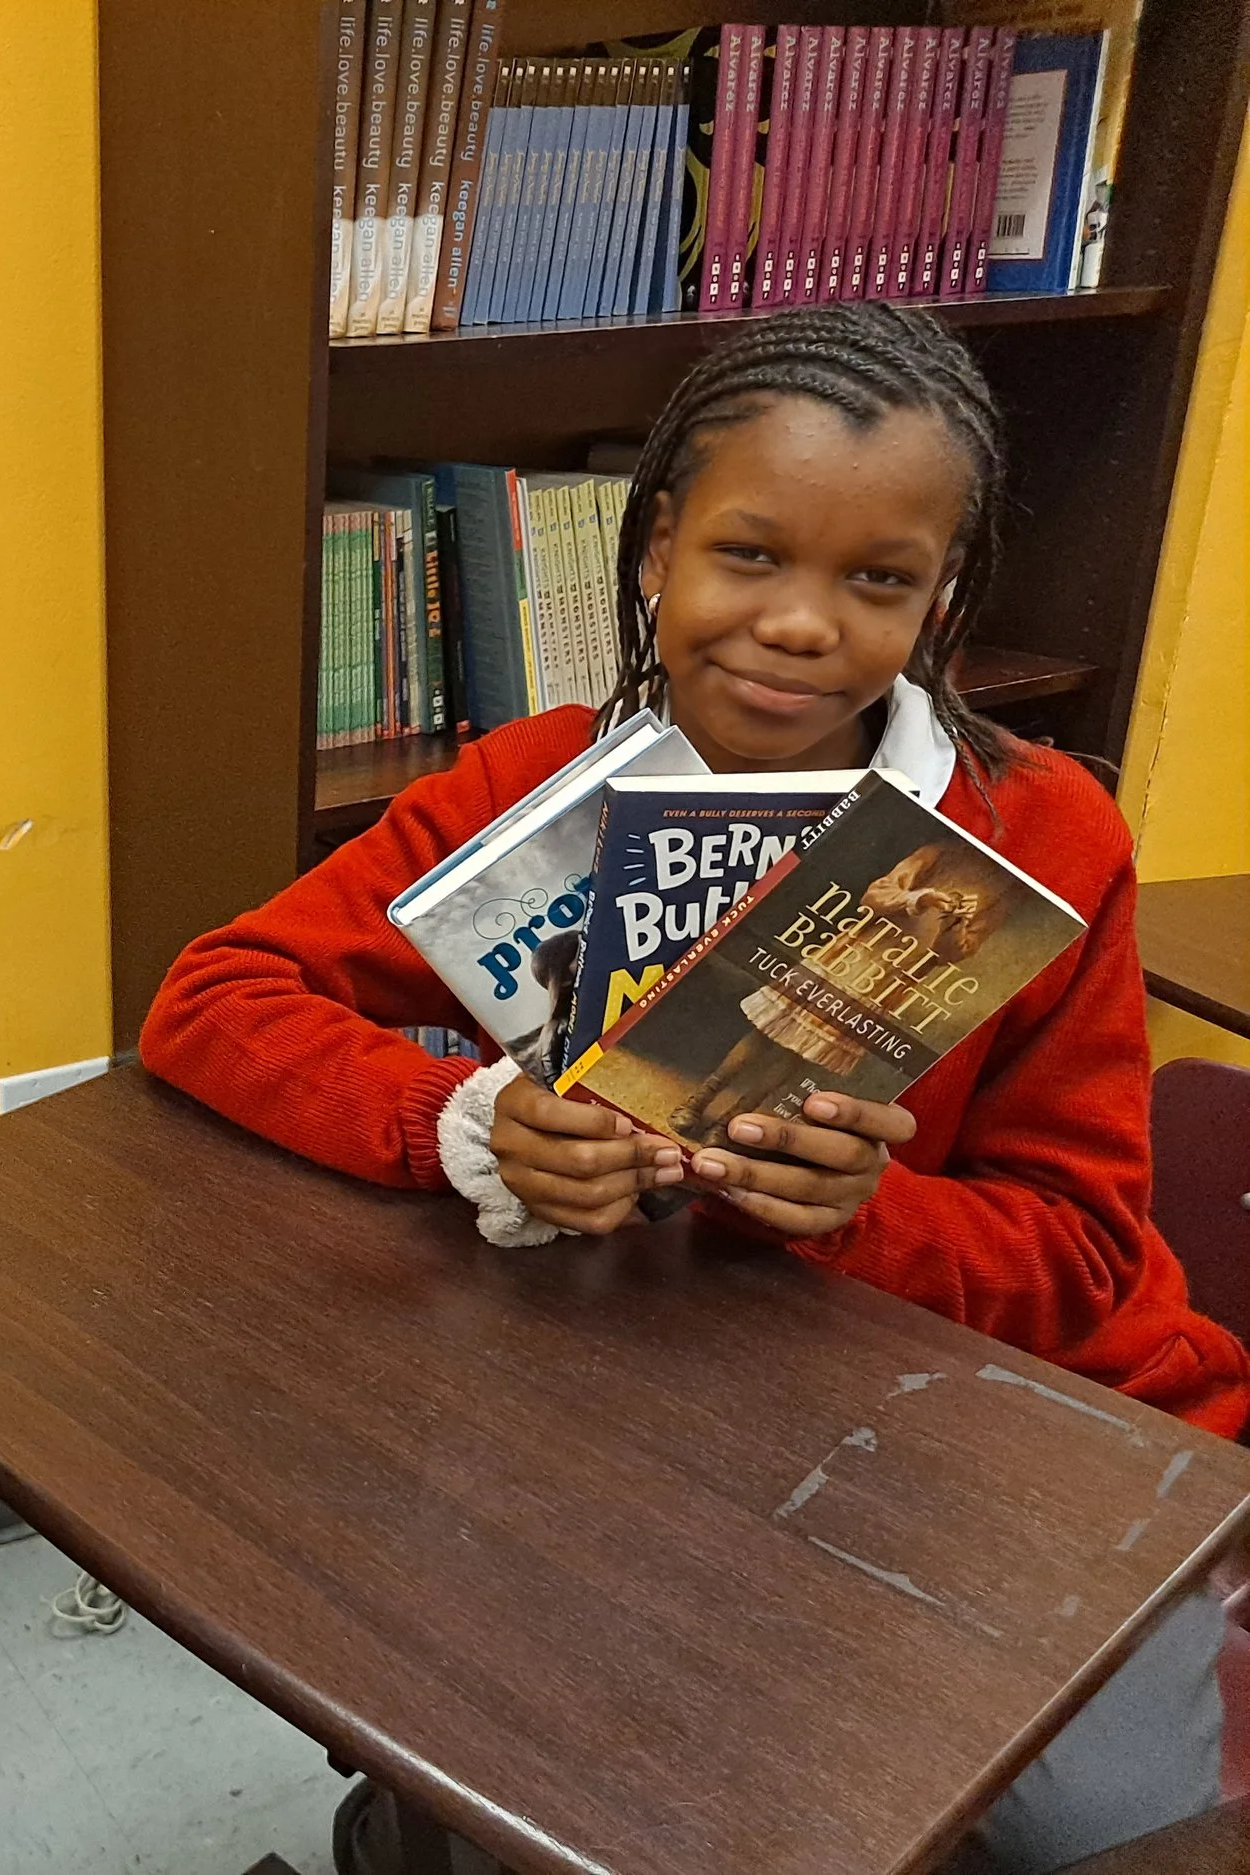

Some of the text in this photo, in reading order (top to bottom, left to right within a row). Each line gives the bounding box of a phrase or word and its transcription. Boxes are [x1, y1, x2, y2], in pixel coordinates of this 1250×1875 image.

[362, 17, 392, 168] life.love.beauty
[396, 18, 428, 168] life.love.beauty
[429, 18, 465, 167] life.love.beauty
[725, 34, 741, 112] Alvarez
[746, 36, 762, 112] Alvarez
[780, 35, 796, 111] Alvarez
[802, 36, 819, 112] Alvarez
[824, 36, 841, 111] Alvarez
[849, 36, 866, 110] Alvarez
[918, 36, 936, 110] Alvarez
[943, 38, 960, 110] Alvarez
[448, 24, 494, 288] life.love.beauty keegan allen
[359, 184, 380, 251] keegan
[390, 183, 412, 250] keegan
[422, 182, 445, 248] keegan
[357, 258, 375, 302] allen
[389, 256, 406, 299] allen
[418, 254, 435, 298] allen
[572, 594, 585, 664] MONSTERS
[587, 592, 599, 661] MONSTERS
[599, 588, 612, 656] MONSTERS
[663, 809, 826, 818] EVEN A BULLY DESERVES A SECOND
[648, 823, 813, 890] BERN
[477, 875, 593, 1000] pro
[639, 895, 755, 1008] TUCK EVERLASTING
[747, 947, 912, 1061] TUCK EVERLASTING
